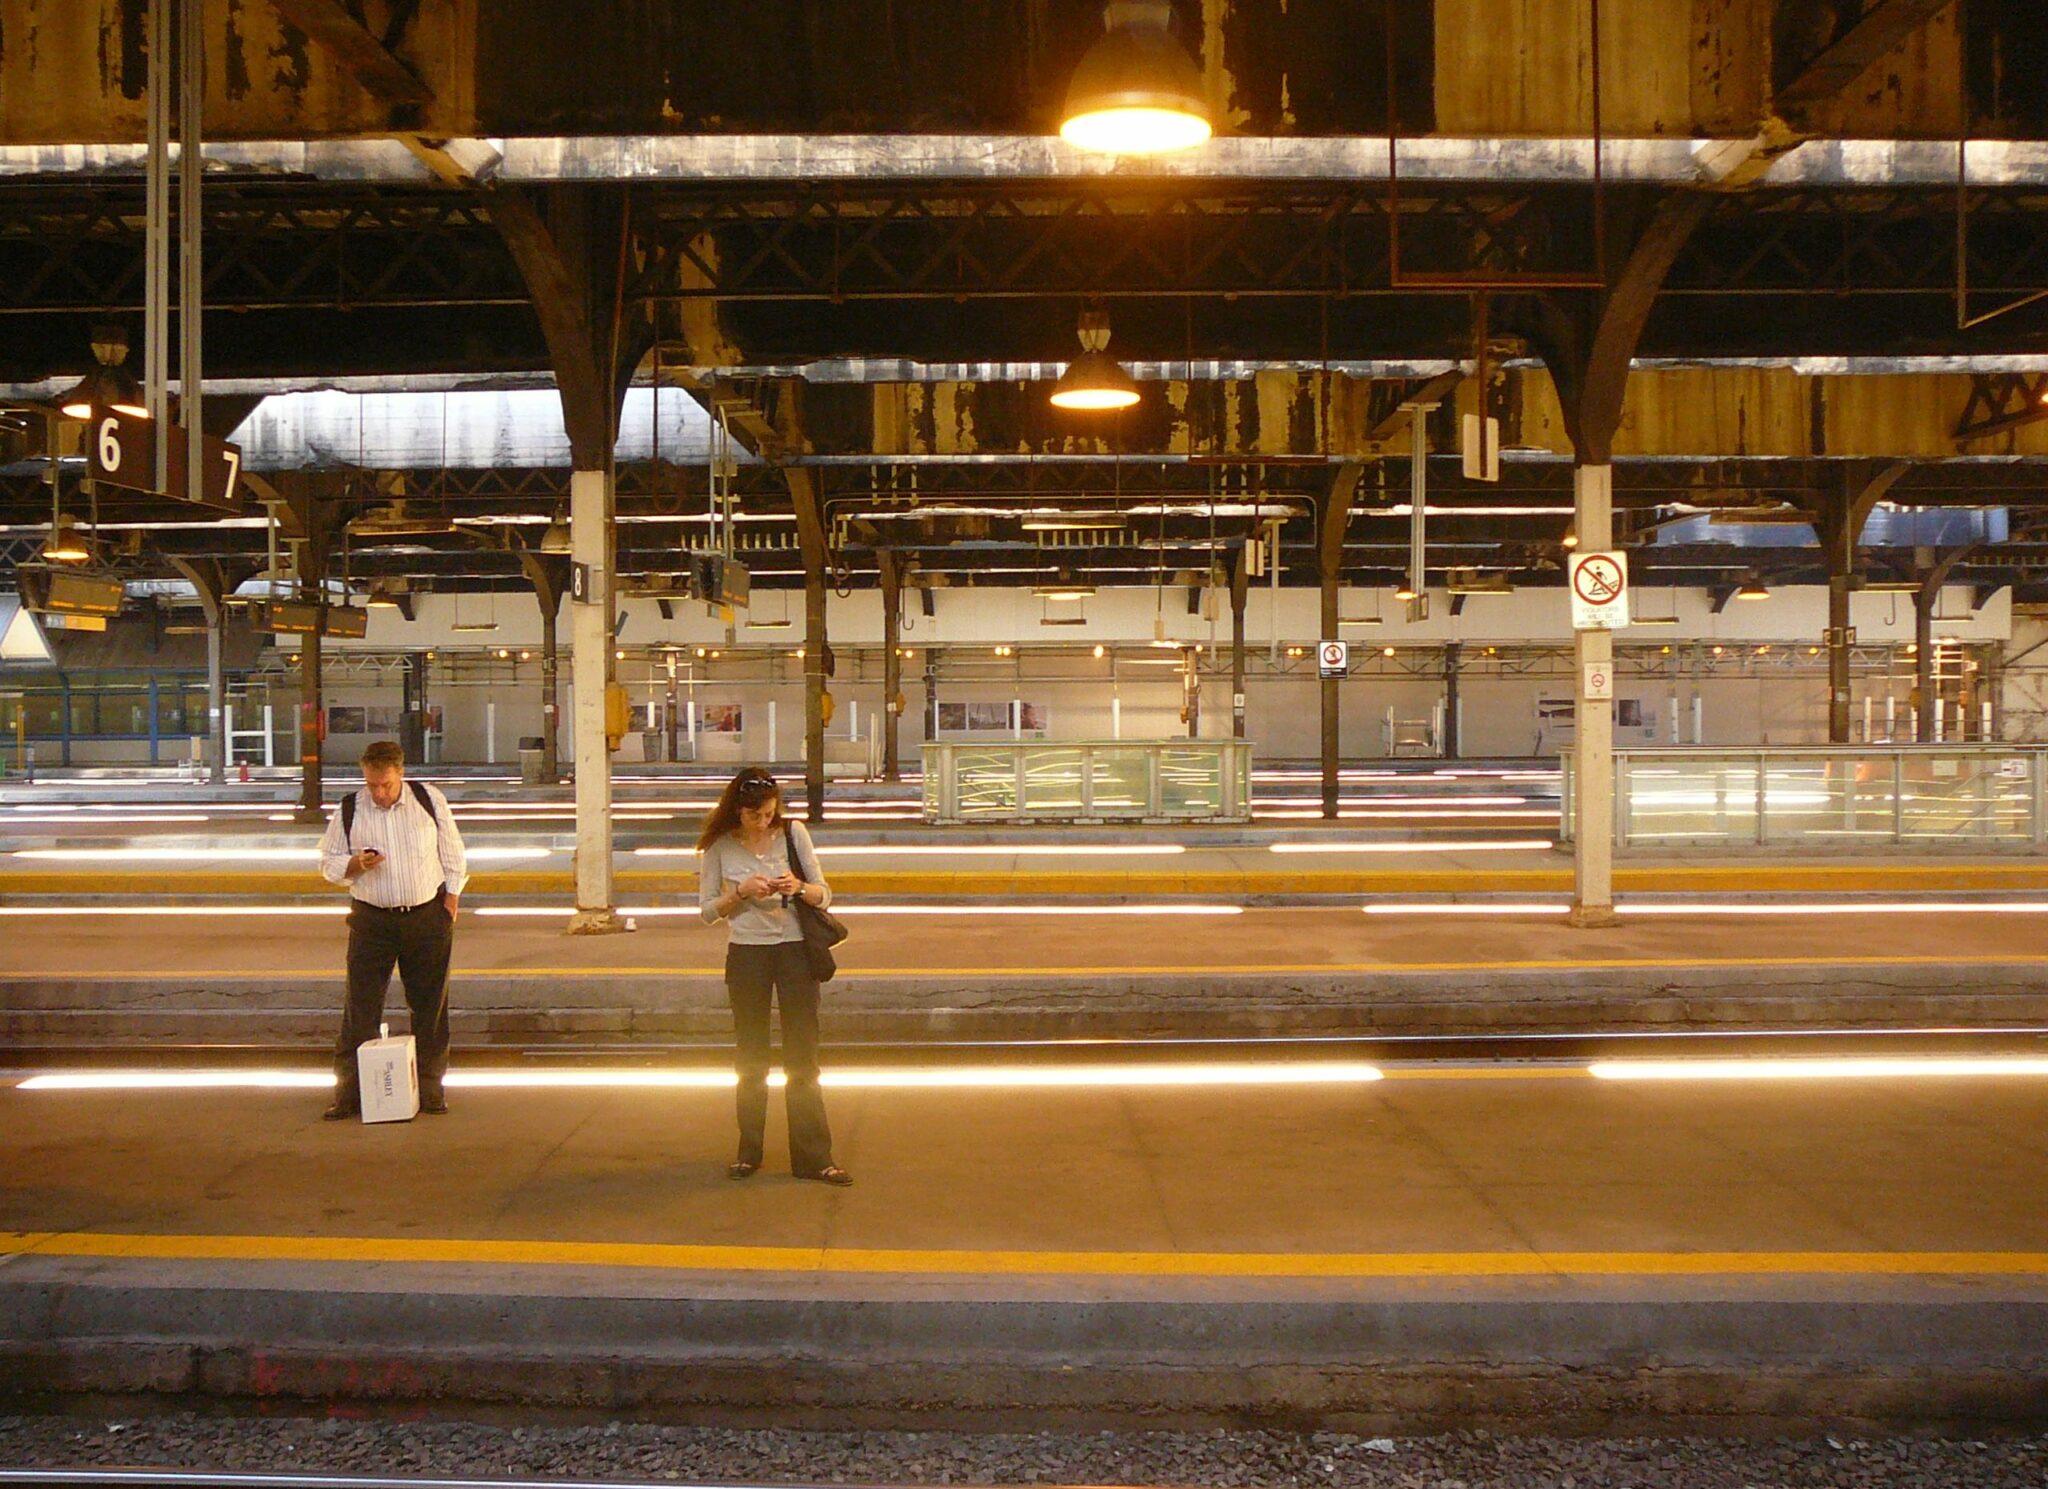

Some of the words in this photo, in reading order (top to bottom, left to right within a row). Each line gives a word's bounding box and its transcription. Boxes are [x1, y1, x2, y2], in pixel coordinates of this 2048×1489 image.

[99, 417, 121, 473] 6
[222, 450, 239, 499] 7
[574, 567, 582, 597] 8
